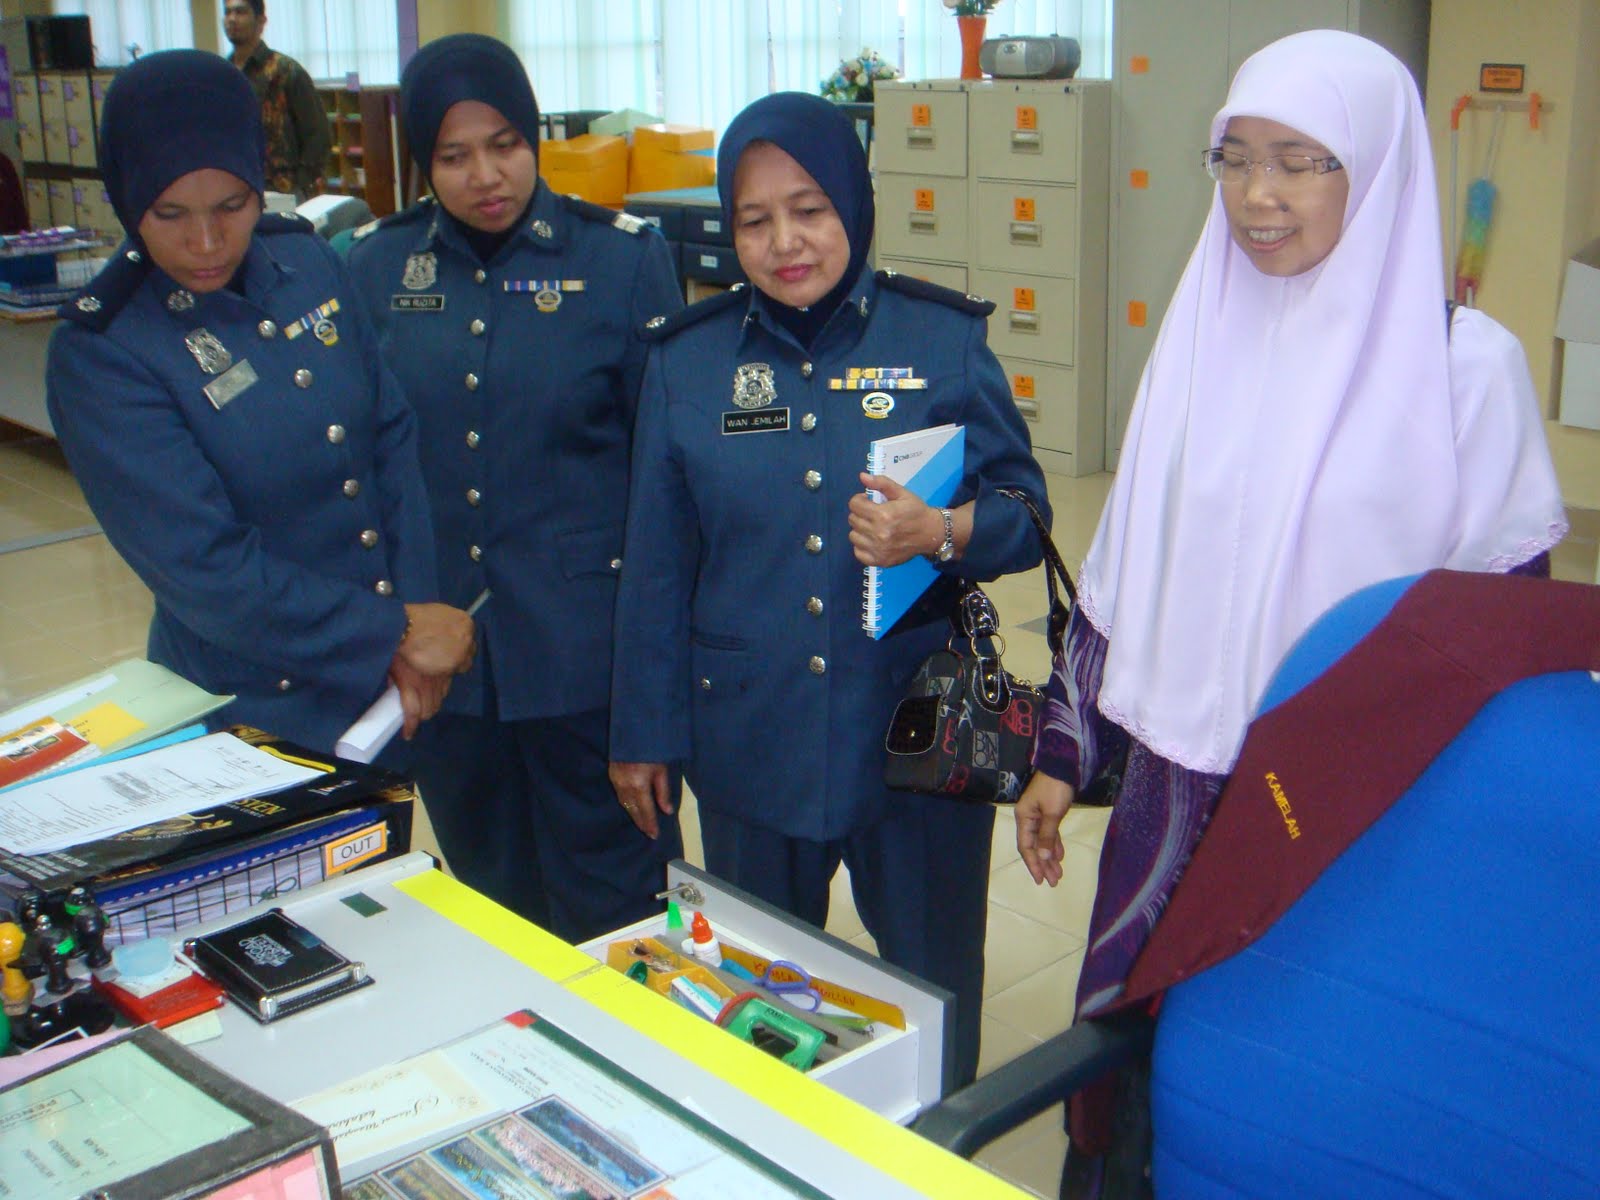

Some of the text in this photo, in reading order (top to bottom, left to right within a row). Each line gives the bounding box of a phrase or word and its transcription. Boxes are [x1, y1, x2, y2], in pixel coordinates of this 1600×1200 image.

[727, 418, 748, 427] WAN
[1264, 771, 1301, 840] KAMELAH
[341, 836, 374, 859] OUT
